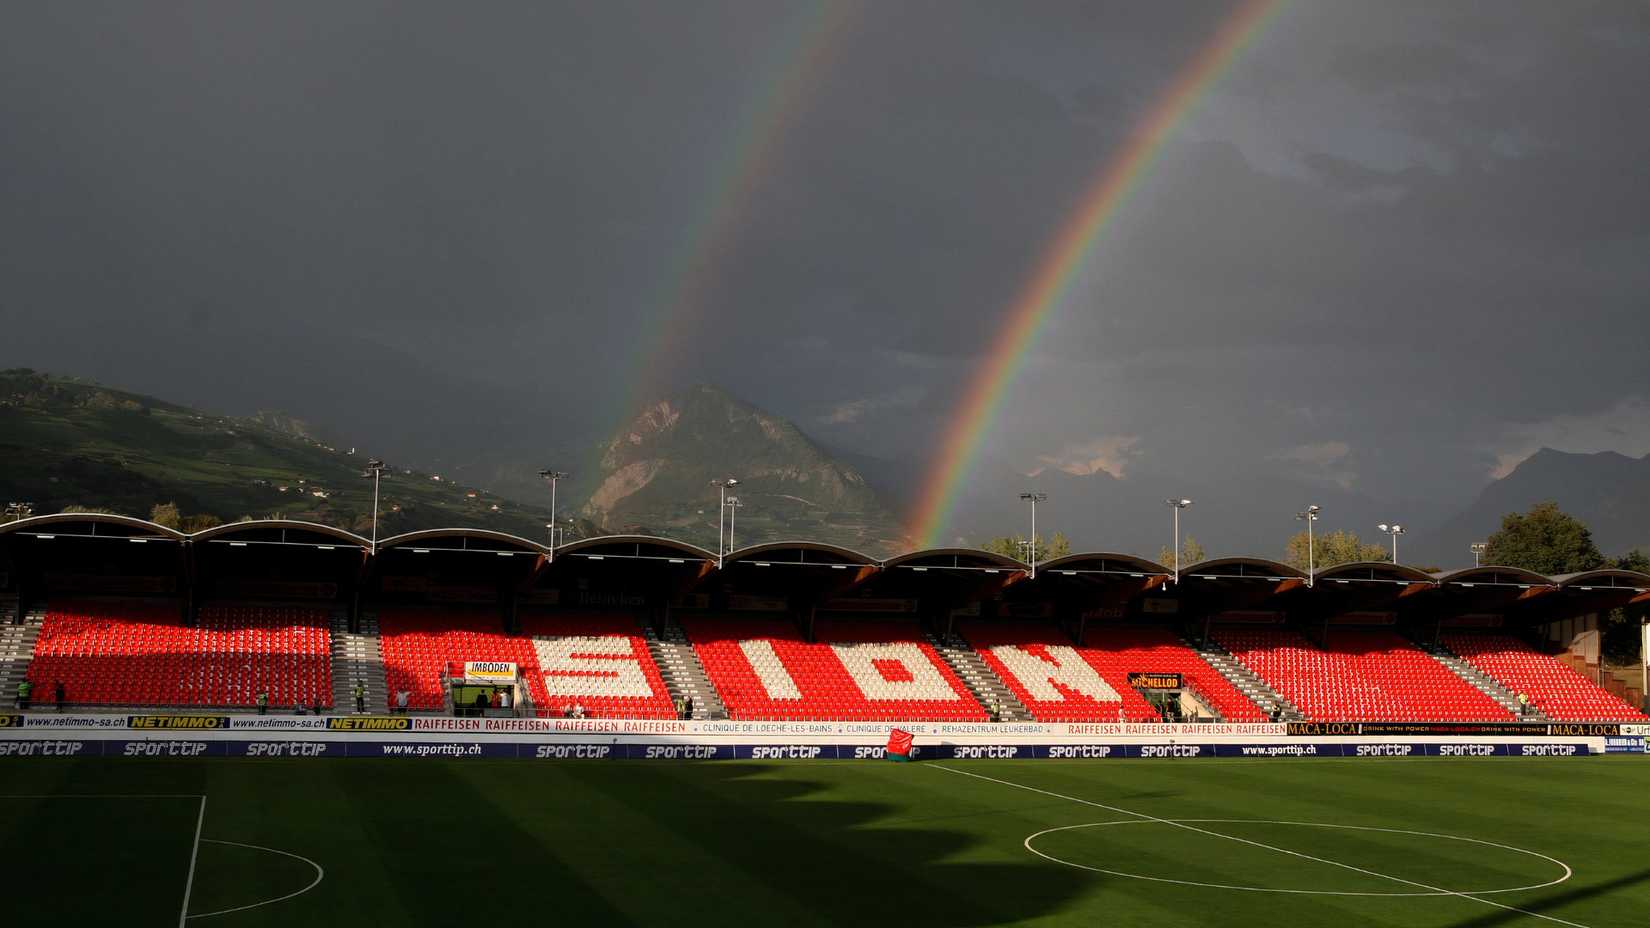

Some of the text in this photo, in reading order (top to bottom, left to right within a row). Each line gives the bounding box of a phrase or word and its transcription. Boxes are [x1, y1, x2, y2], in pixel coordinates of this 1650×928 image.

[472, 662, 510, 672] IMBODEN
[26, 717, 125, 728] www.netimmo-sa.ch
[131, 716, 218, 728] NETIMMO
[233, 718, 325, 729] www.netimmo-sa.ch
[329, 718, 408, 729] NETIMMO
[415, 718, 686, 732] RAIFFEISEN RAIFFEISEN RAIFFEISEN RAIFFEISEN
[703, 724, 739, 732] CLINIQUE
[742, 724, 753, 732] DE
[1068, 724, 1286, 734] RAIFFEISEN RAIFFEISEN RAIFFEISEN RAIFFEISEN
[1288, 723, 1357, 735] MACA-LOCA
[1552, 724, 1619, 736] MACA-LOCA
[383, 743, 482, 757] www.sporttip.ch
[1242, 745, 1317, 757] www.sporttip.ch
